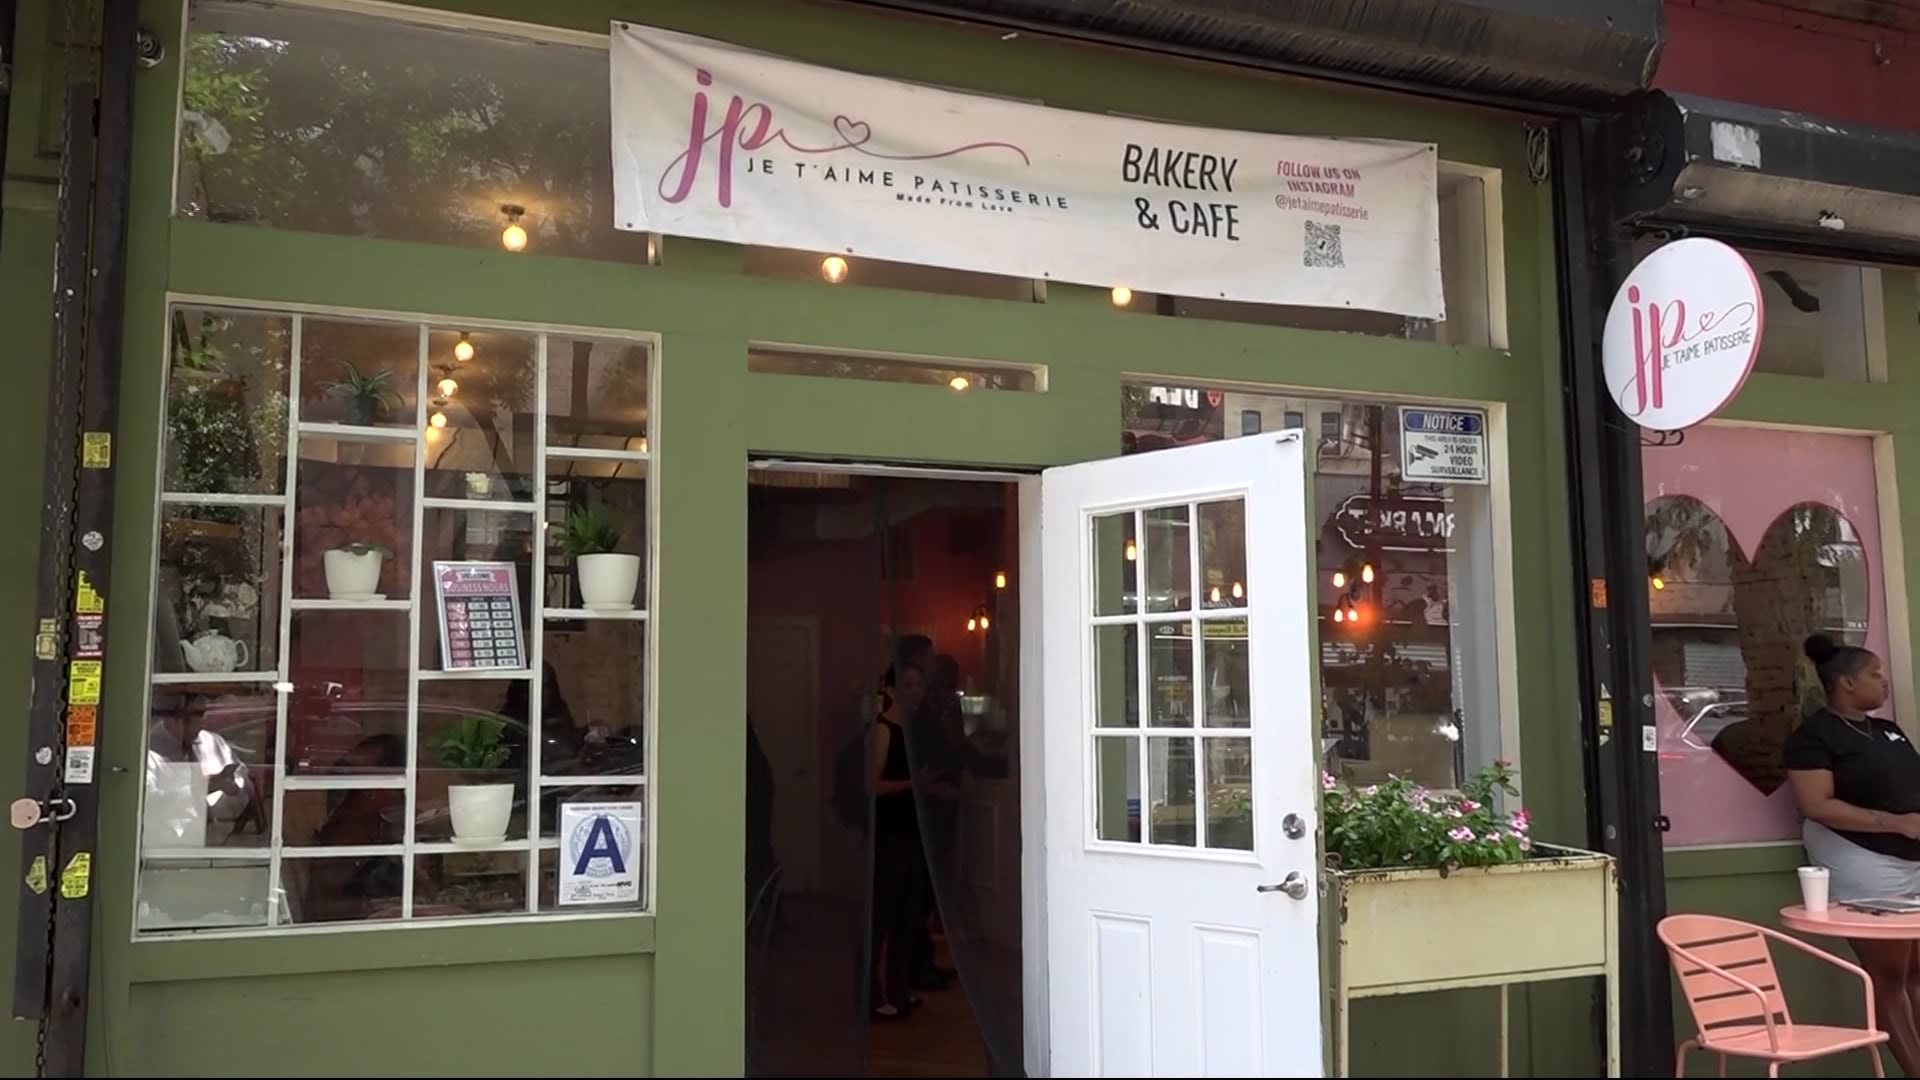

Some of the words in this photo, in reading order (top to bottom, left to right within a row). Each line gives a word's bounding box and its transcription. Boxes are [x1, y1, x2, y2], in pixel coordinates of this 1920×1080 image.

[1122, 143, 1239, 192] BAKERY
[1277, 160, 1321, 178] FOLLOW
[1323, 167, 1341, 179] US
[1342, 168, 1361, 180] ON
[747, 157, 774, 174] JE
[914, 176, 1068, 209] PATISSERIE
[1287, 181, 1355, 197] INSTAGRAM
[1275, 193, 1369, 220] @jetaimepatisserie
[1135, 197, 1160, 230] &
[1168, 200, 1240, 241] CAFE
[1704, 326, 1752, 356] PATISSERIE
[1423, 413, 1465, 432] NOTICE
[1444, 444, 1454, 454] 24
[1456, 445, 1478, 455] HOUR
[1449, 456, 1474, 466] VIDEO
[1431, 466, 1478, 476] SURVEILLANCE
[573, 815, 628, 875] A
